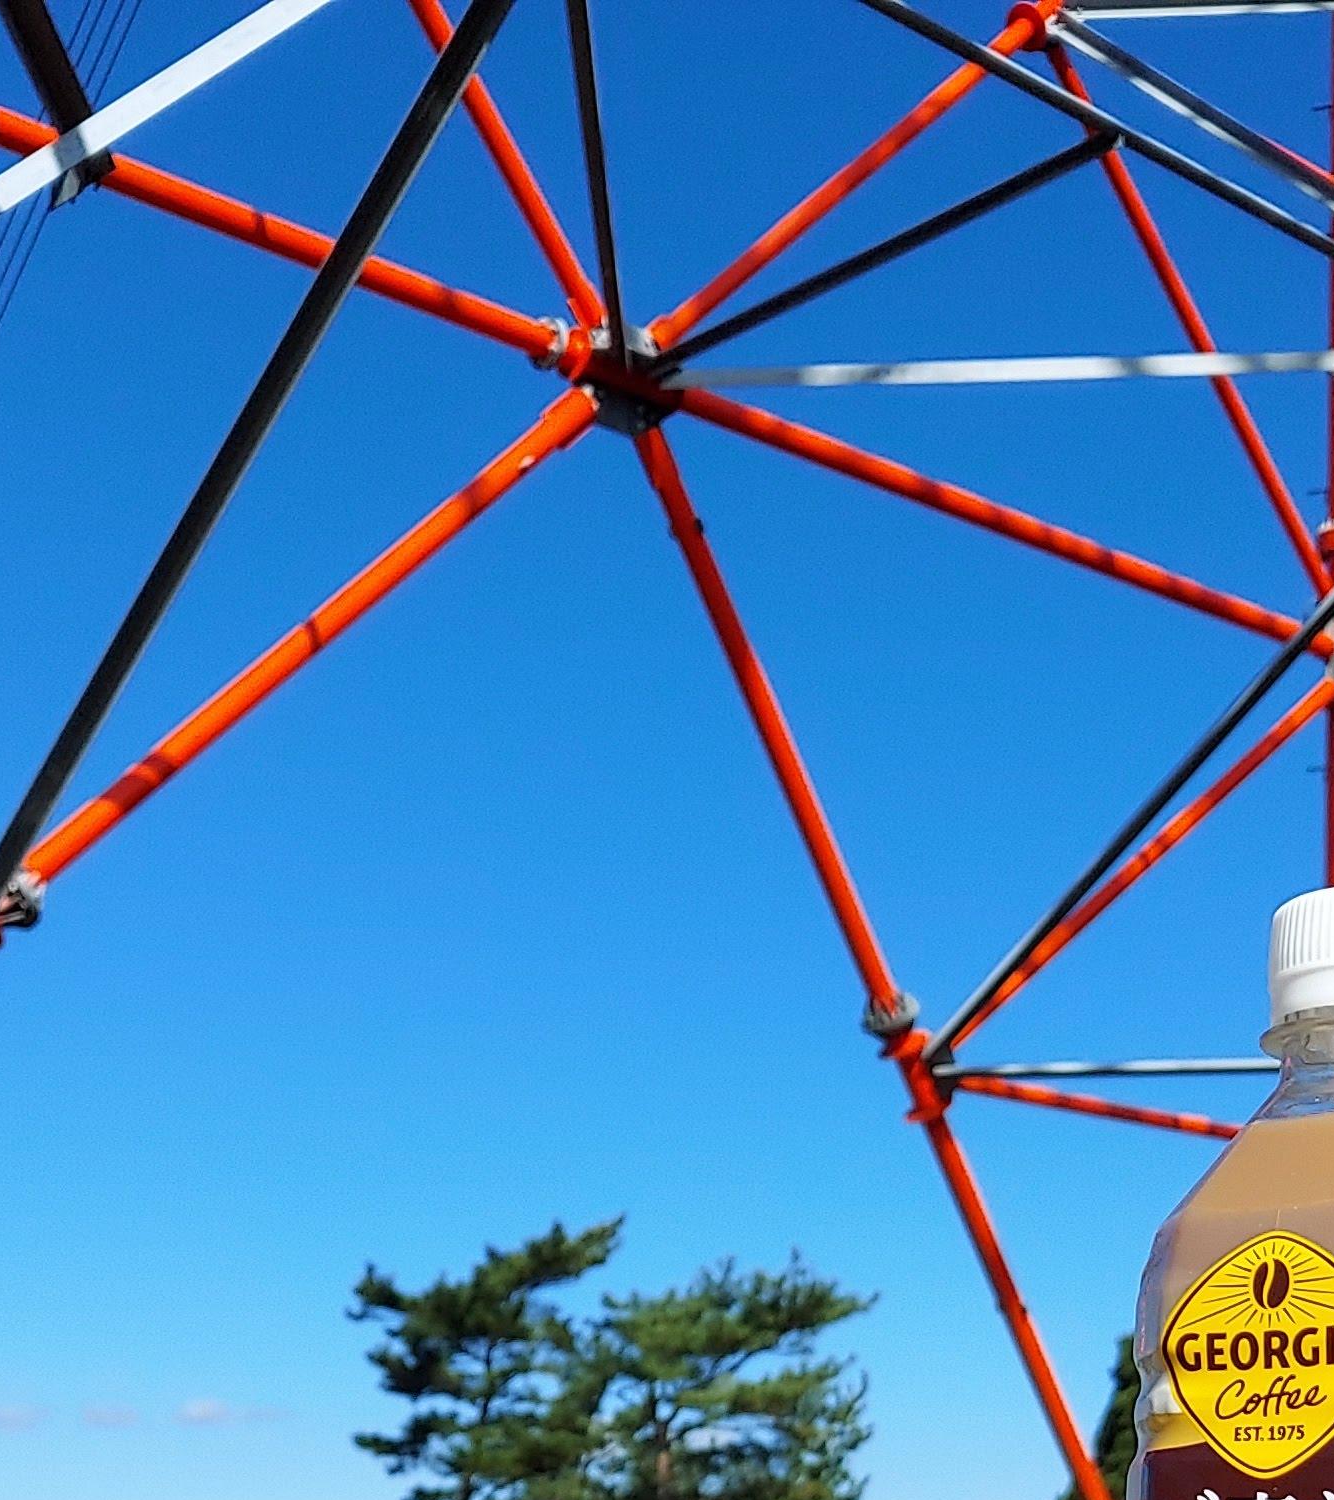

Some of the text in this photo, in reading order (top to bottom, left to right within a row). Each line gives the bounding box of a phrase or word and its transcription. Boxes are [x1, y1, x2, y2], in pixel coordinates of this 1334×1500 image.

[1214, 1373, 1328, 1420] Coffee
[1233, 1424, 1306, 1442] EST. 1975
